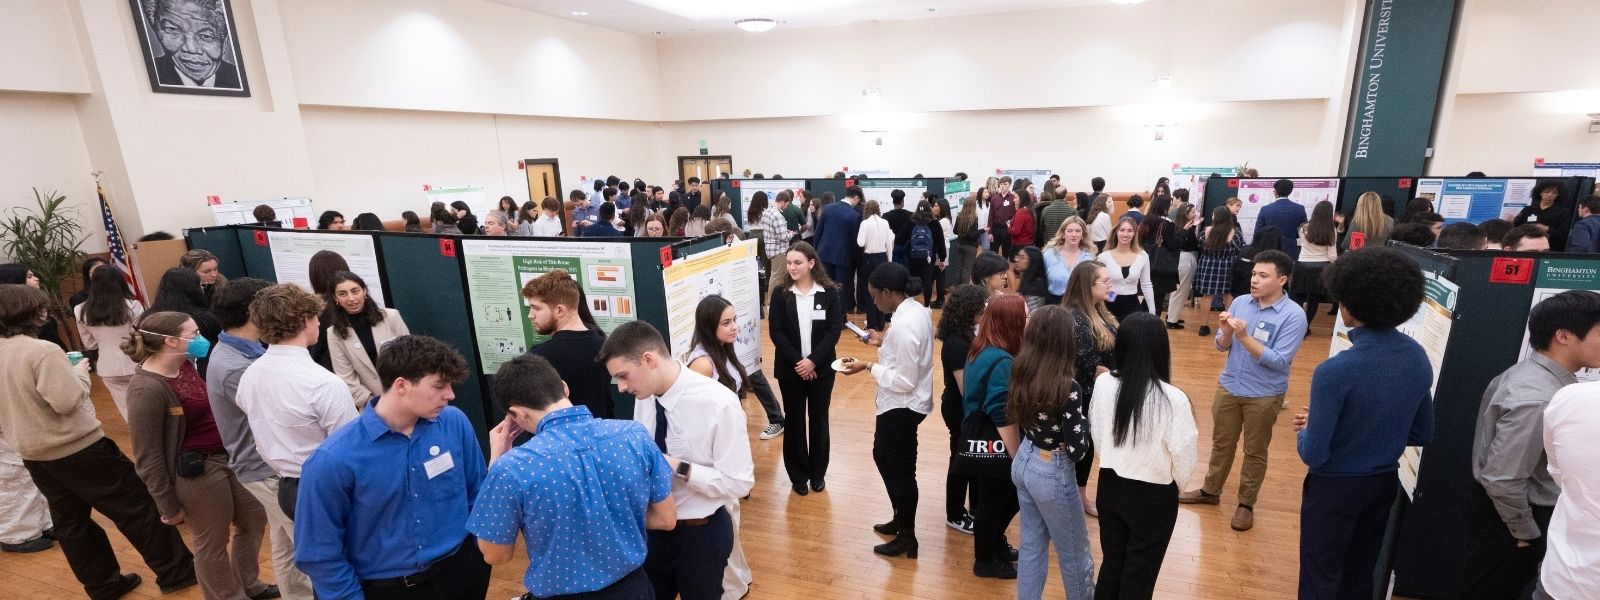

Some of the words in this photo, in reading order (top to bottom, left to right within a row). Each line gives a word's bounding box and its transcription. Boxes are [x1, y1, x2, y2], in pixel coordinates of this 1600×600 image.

[1354, 73, 1381, 159] BINGHAMTON
[1505, 265, 1520, 275] 51
[1547, 266, 1597, 275] BINGHAMTON
[967, 440, 1006, 453] TRIO
